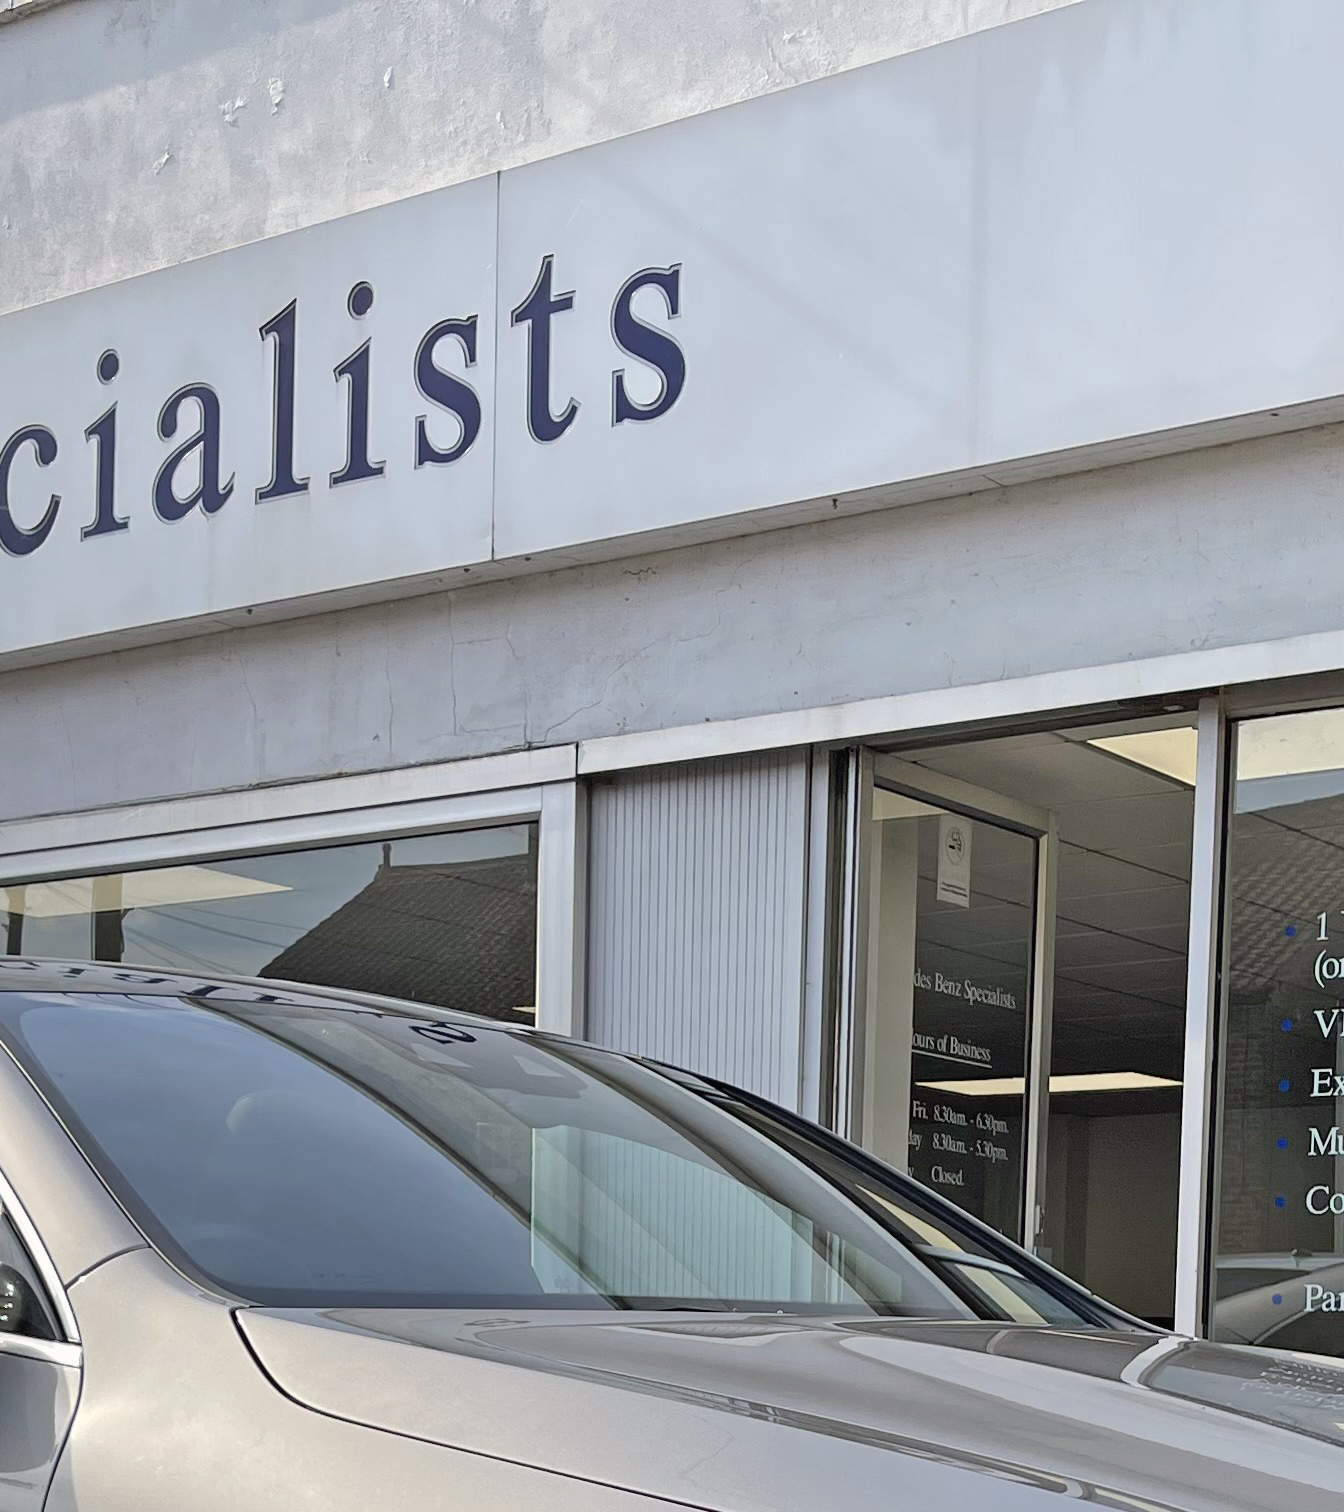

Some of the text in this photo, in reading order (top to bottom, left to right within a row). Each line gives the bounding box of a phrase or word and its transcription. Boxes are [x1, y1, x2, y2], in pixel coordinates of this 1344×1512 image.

[1316, 911, 1329, 941] 1
[935, 971, 962, 997] Benz
[964, 979, 1016, 1010] Specialists
[912, 1028, 992, 1062] ours of Business
[912, 1100, 929, 1119] Fri.
